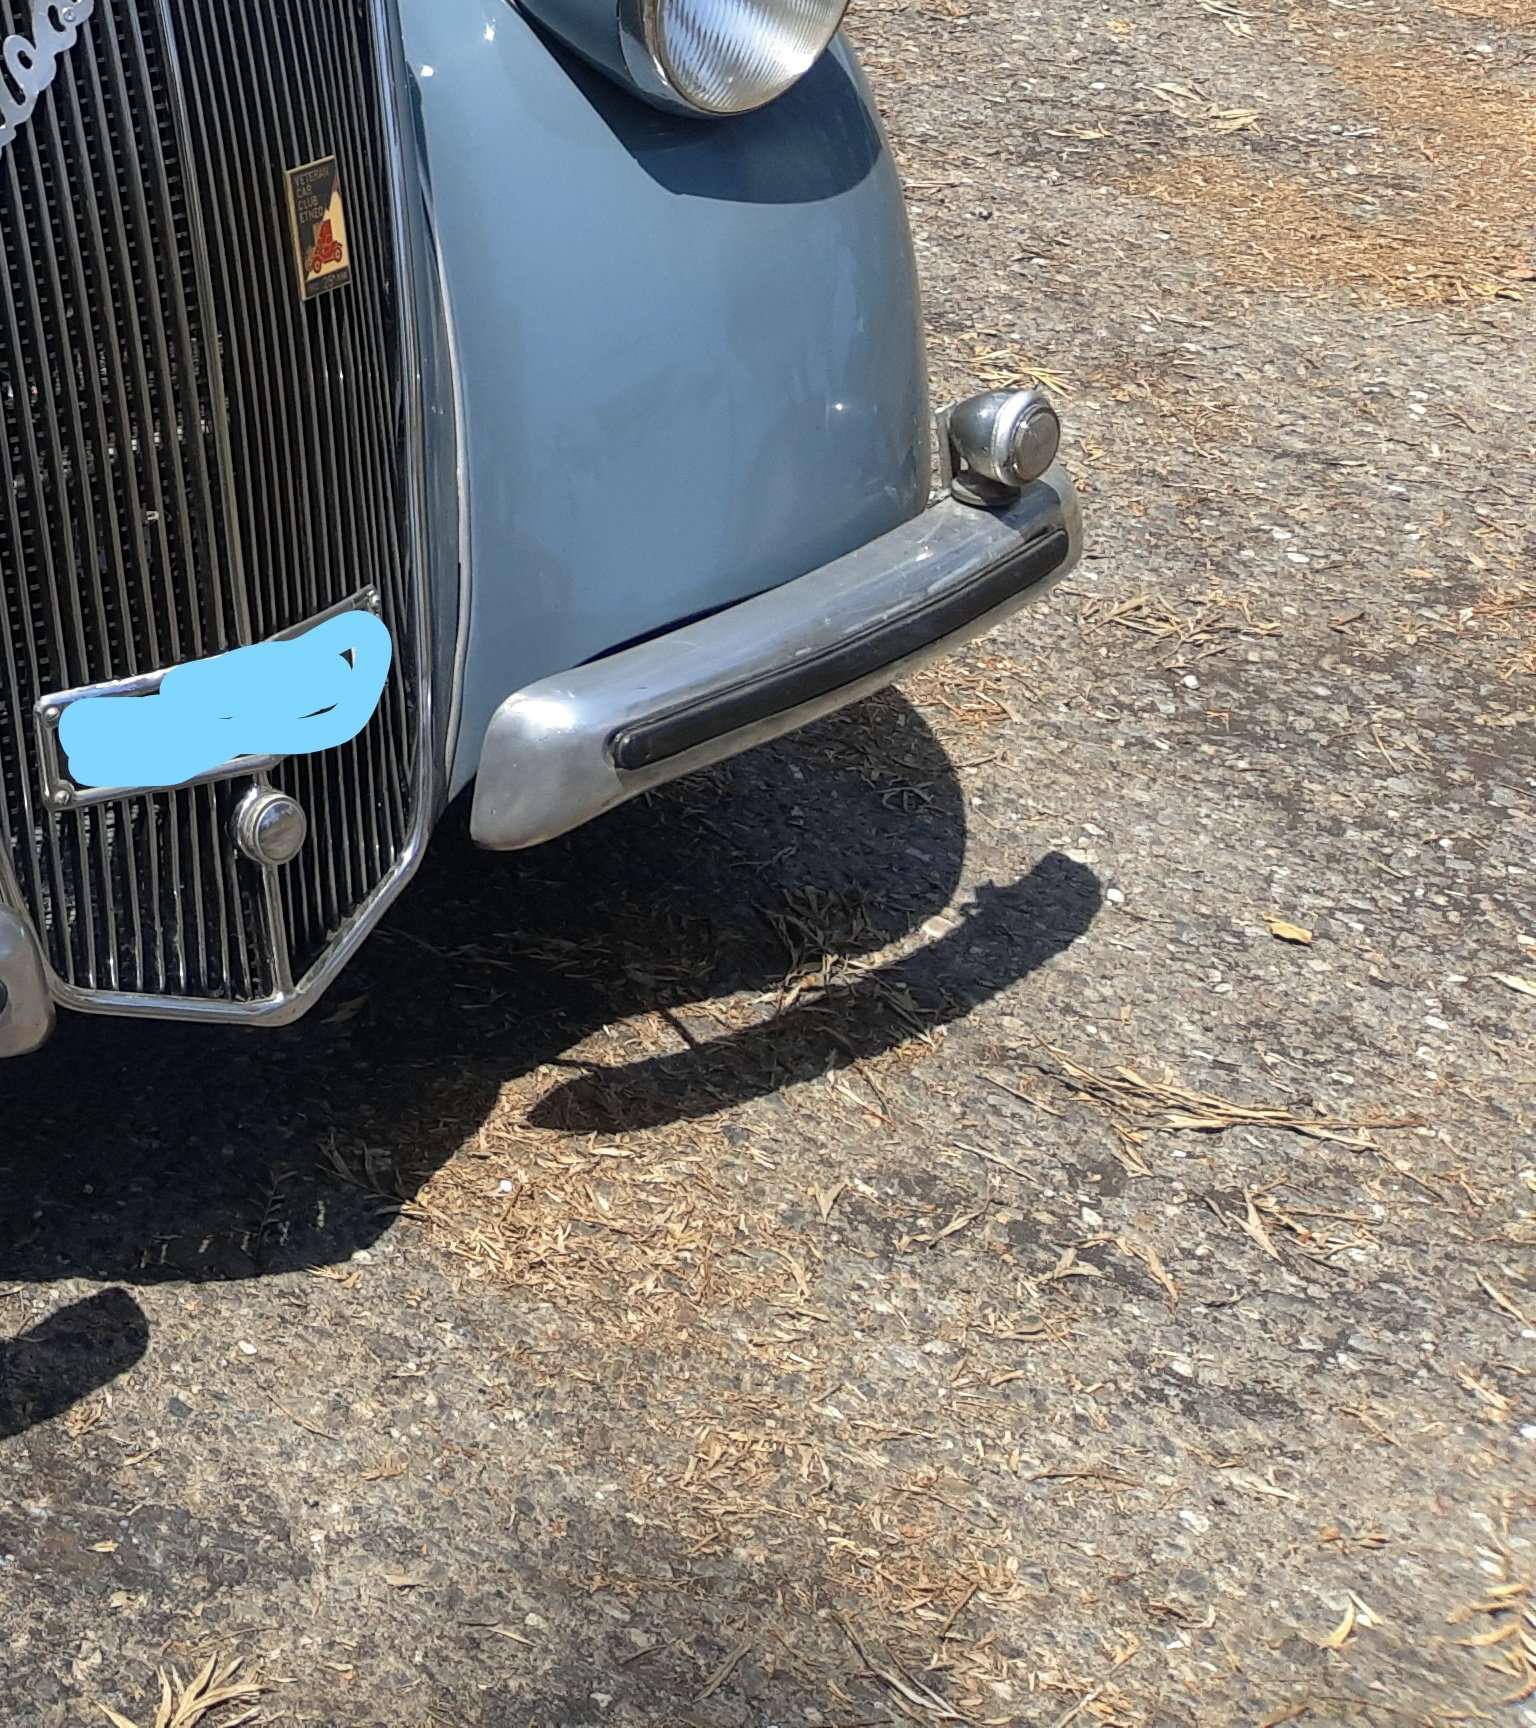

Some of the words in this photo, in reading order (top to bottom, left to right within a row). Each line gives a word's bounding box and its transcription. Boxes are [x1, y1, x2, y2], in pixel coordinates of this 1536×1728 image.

[294, 166, 330, 186] VETERAN
[296, 185, 313, 198] CAR
[297, 196, 320, 211] CLUB
